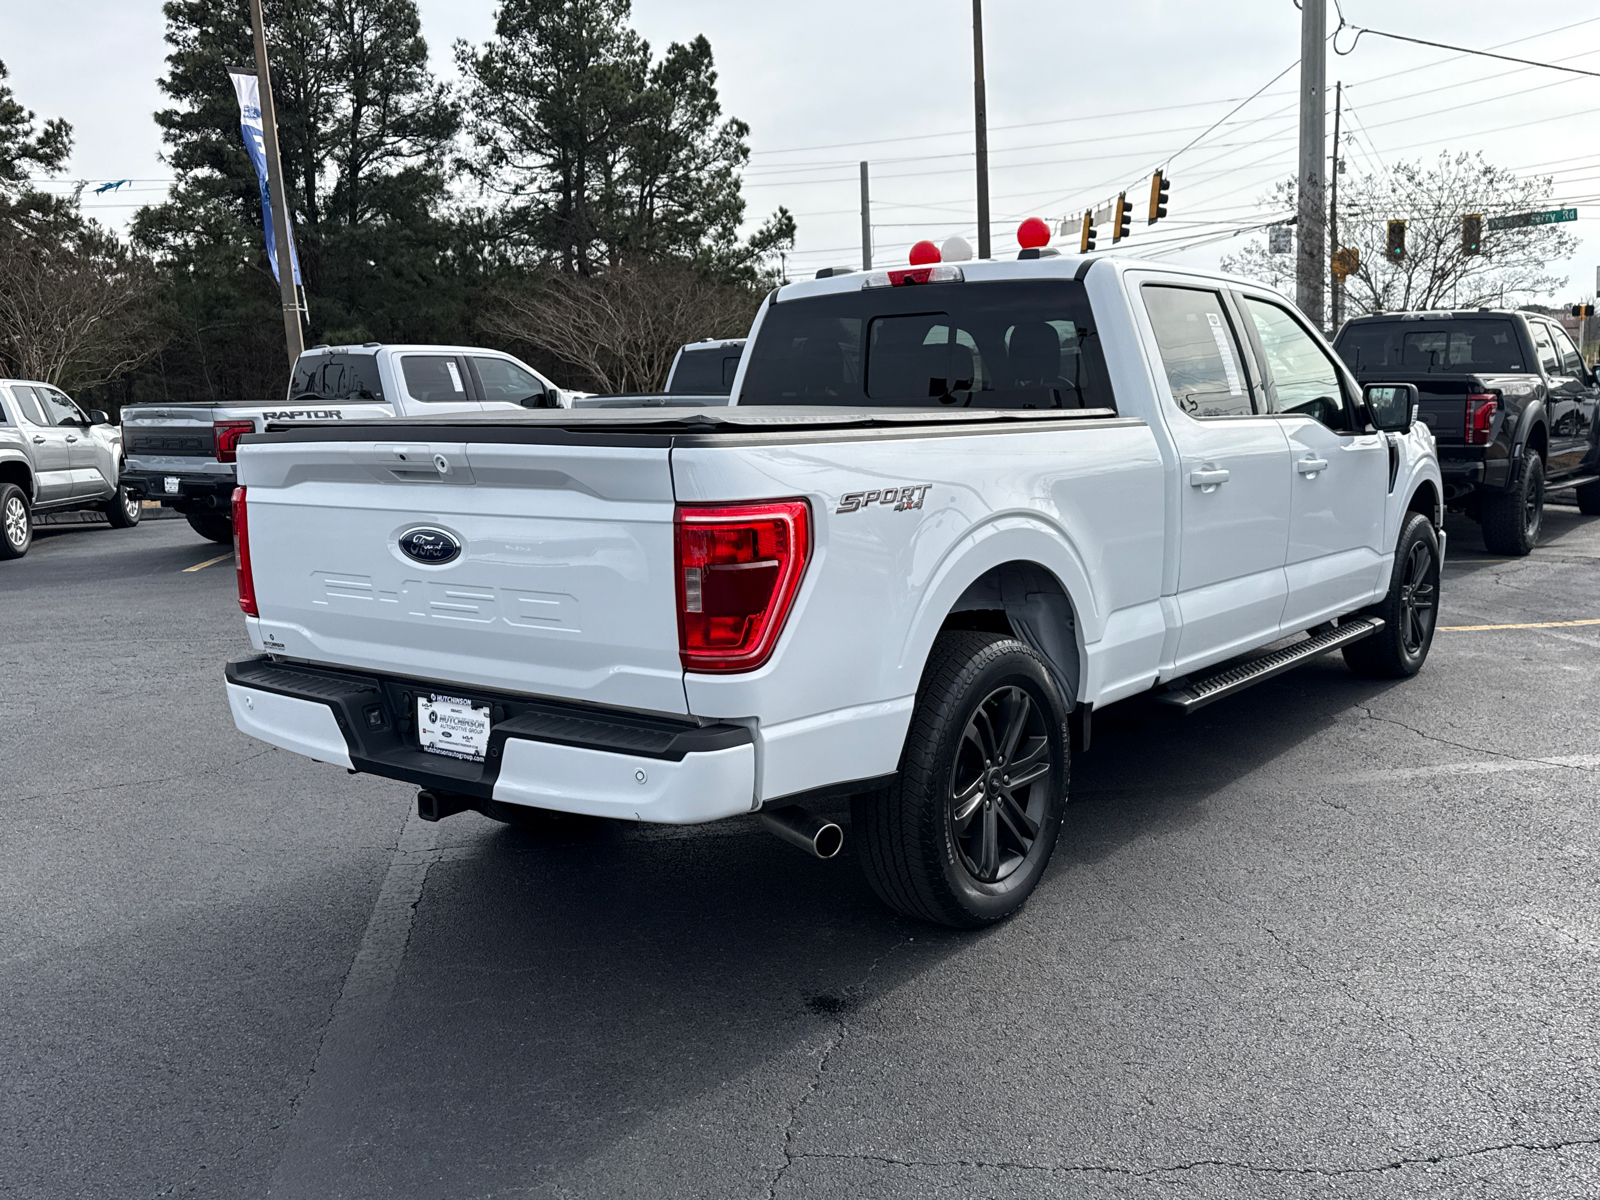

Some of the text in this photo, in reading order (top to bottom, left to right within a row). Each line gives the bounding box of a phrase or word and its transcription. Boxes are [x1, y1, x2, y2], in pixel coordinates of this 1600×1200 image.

[1562, 209, 1575, 220] Rd
[262, 409, 343, 421] RAPTOR
[836, 484, 932, 515] SPORT
[893, 501, 923, 512] 4x4
[437, 694, 471, 706] HUTCHINSON
[439, 714, 486, 729] HUTCHINSON
[440, 723, 468, 733] AUTOMOTIVE
[468, 727, 484, 735] GROUP
[423, 745, 485, 762] Hutchinsonautogroup.com
